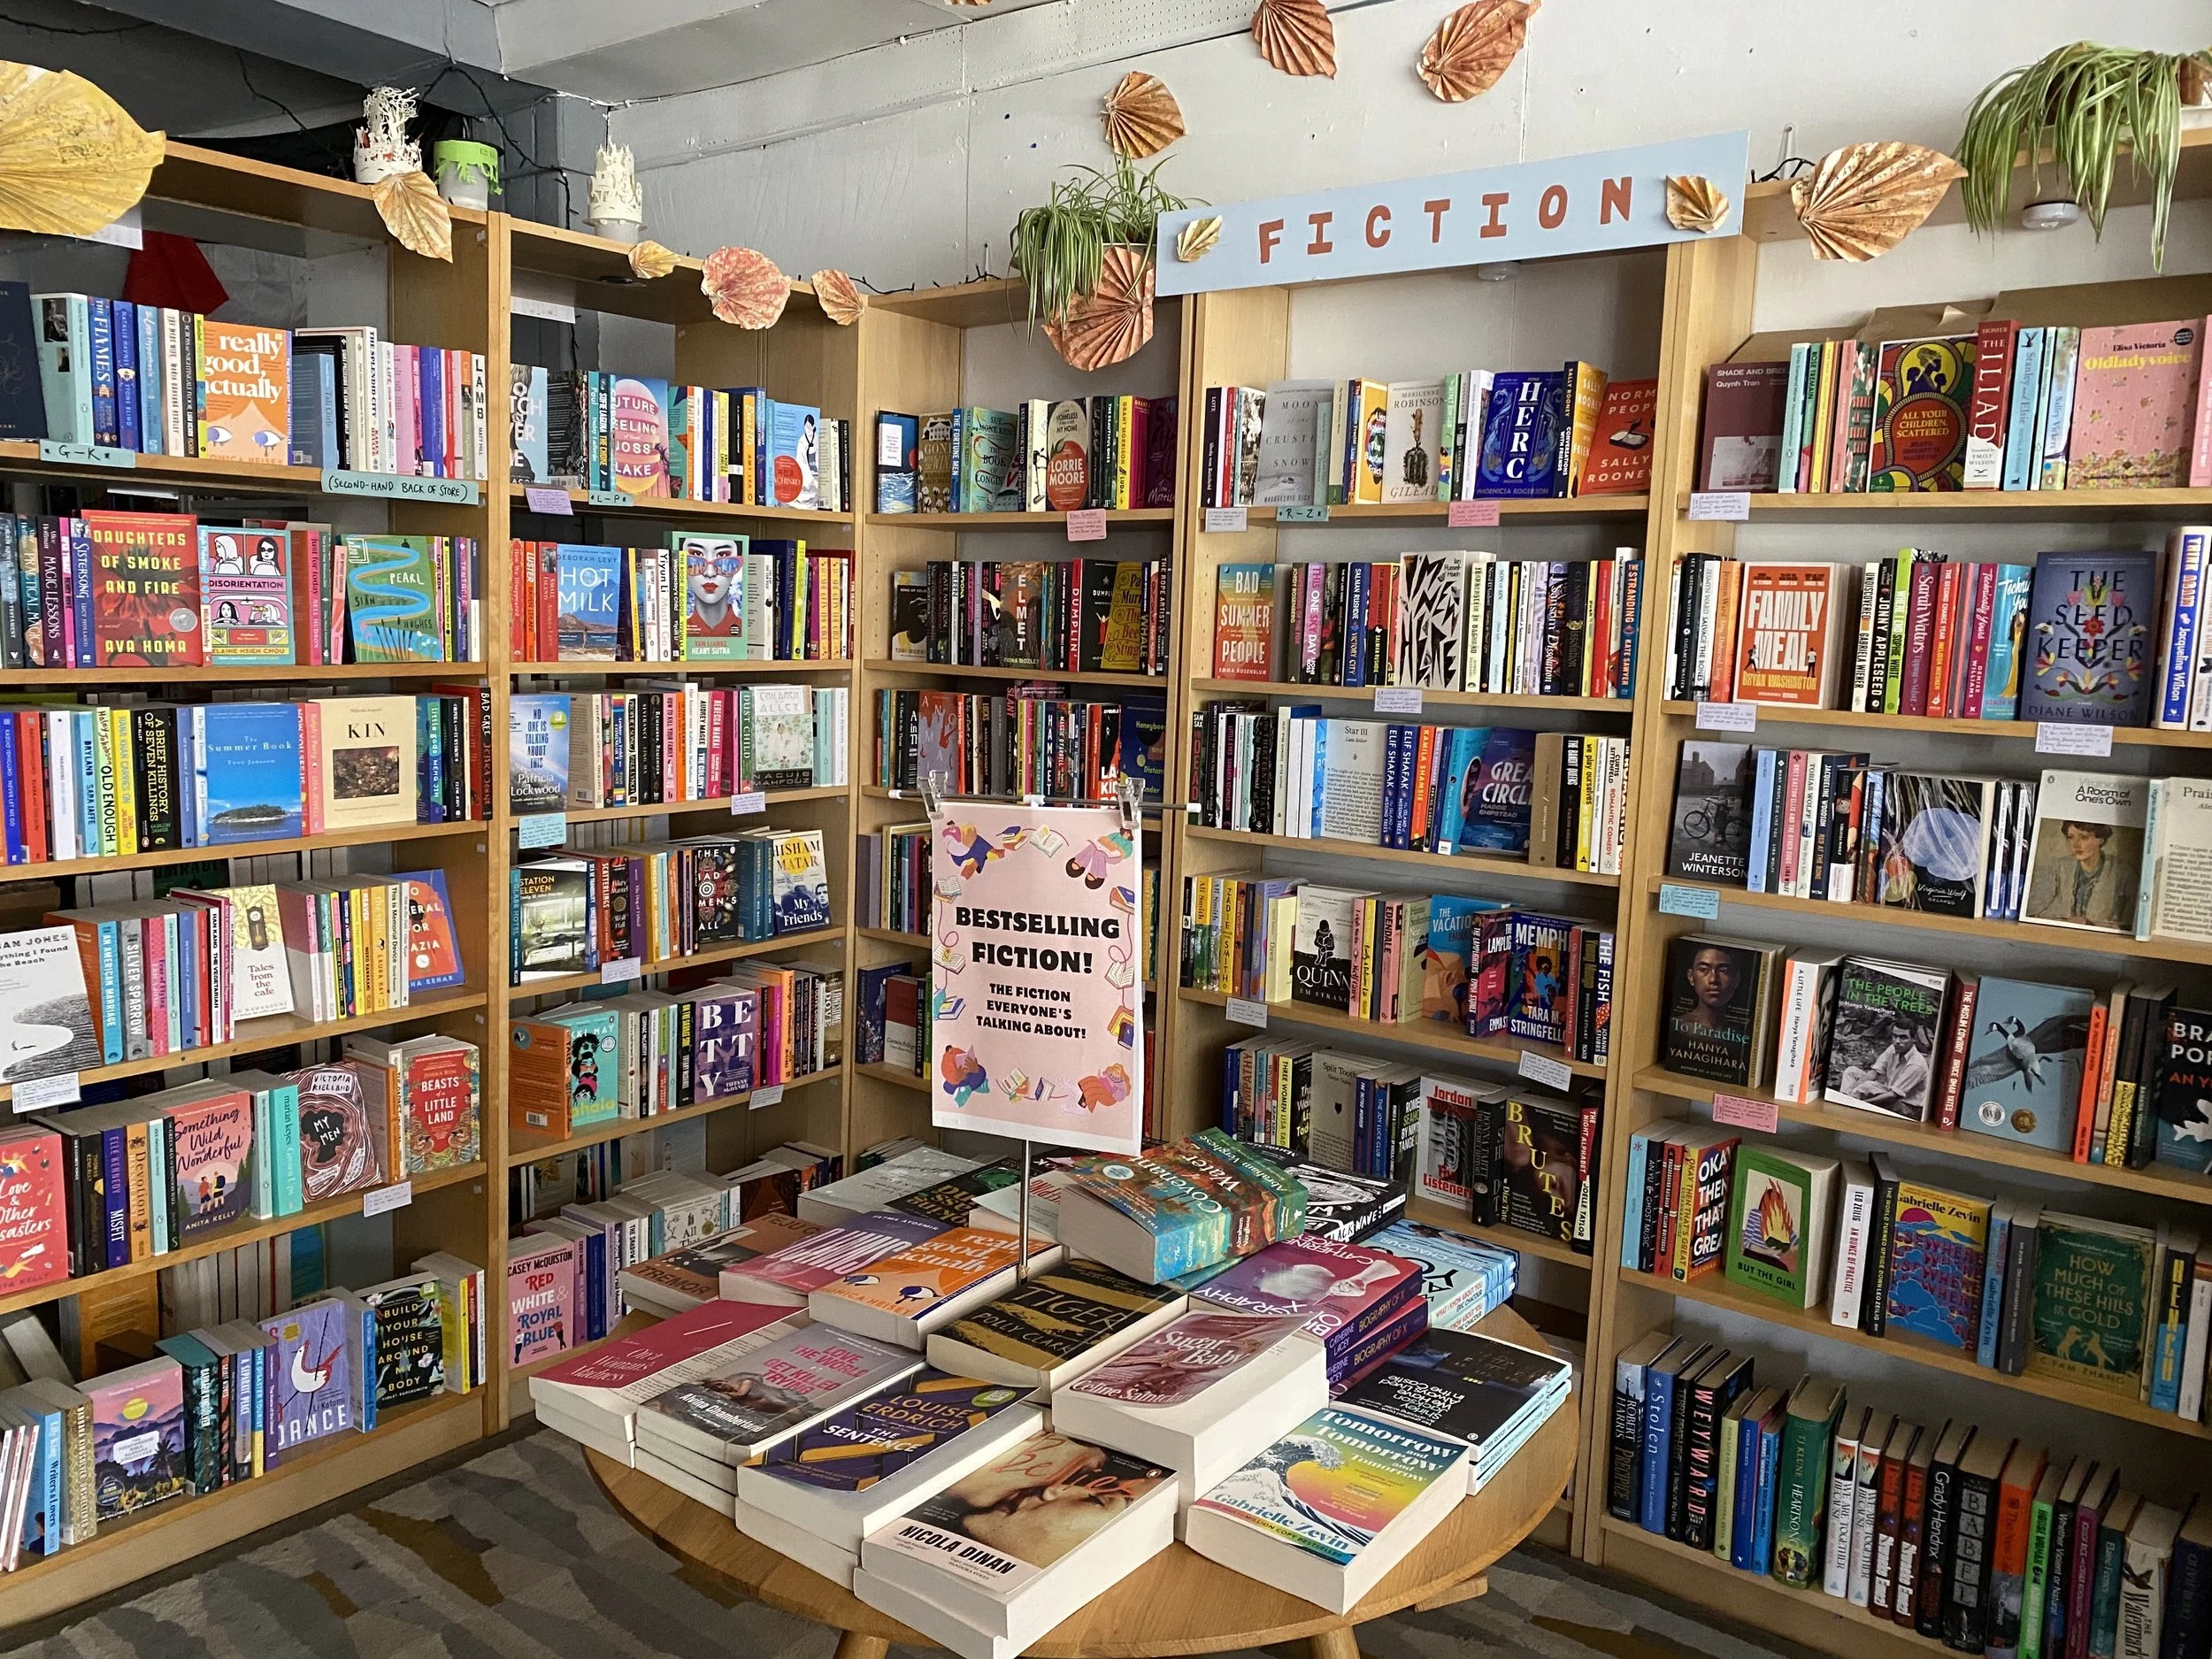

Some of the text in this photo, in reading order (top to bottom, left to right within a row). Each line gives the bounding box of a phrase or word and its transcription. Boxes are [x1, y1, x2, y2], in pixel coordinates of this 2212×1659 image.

[1259, 176, 1632, 264] FICTION
[219, 332, 281, 361] really
[204, 356, 266, 381] good,
[1717, 380, 1740, 389] Quynh
[1975, 352, 2003, 443] ILIAD
[1900, 419, 1947, 429] CHILDREN
[1902, 410, 1947, 421] ALL YOUR
[1507, 381, 1542, 479] HERC
[1897, 428, 1948, 438] SCATTERED
[1050, 458, 1083, 472] LORRIE
[402, 480, 424, 494] BACK
[427, 484, 435, 494] OF
[1050, 472, 1085, 486] MOORE
[1390, 486, 1438, 497] GILEAD
[94, 531, 185, 546] DAUGHTERS
[101, 557, 180, 570] OF SMOKE
[209, 580, 284, 590] DISORIENTATION
[390, 573, 424, 585] PEARL
[560, 568, 612, 586] HOT
[1235, 572, 1259, 594] BAD
[106, 581, 179, 594] AND FIRE
[662, 584, 667, 594] Li
[559, 591, 613, 612] MILK
[1221, 605, 1270, 627] SUMMER
[1748, 591, 1824, 632] FAMILY
[403, 619, 432, 629] HUGHES
[105, 641, 186, 652] AVA HOMA
[1222, 641, 1265, 664] PEOPLE
[1754, 630, 1807, 672] MEAL
[1871, 597, 1889, 695] JONNY APPLESEED
[534, 709, 541, 718] NO
[349, 722, 386, 738] KIN
[528, 719, 546, 732] ONE IS
[1345, 726, 1359, 735] Star
[526, 733, 549, 744] TALKING
[528, 745, 547, 757] ABOUT
[1386, 728, 1398, 790] ELIF SHAFAK
[531, 757, 543, 768] THIS
[518, 772, 554, 784] Patricia
[511, 782, 560, 795] Lockwood
[2087, 787, 2117, 796] Room
[101, 766, 115, 841] OLD ENOUGH
[2076, 795, 2131, 806] One's Own
[1689, 853, 1744, 866] JEANETTE
[520, 875, 554, 886] STATION
[520, 885, 550, 895] ELEVEN
[794, 898, 808, 910] My
[784, 910, 823, 926] Friends
[956, 906, 1120, 939] BESTSELLING
[972, 941, 1093, 974] FICTION!
[248, 964, 274, 972] Tales
[250, 972, 273, 981] from
[103, 948, 115, 1026] AMERICAN MARRIAGE
[126, 941, 143, 1034] SILVER SPARROW
[990, 983, 1071, 1002] THE FICTION
[987, 1000, 1071, 1020] EVERYONE'S
[976, 1016, 1087, 1039] TALKING ABOUT!
[1674, 1019, 1750, 1044] To Paradise
[313, 1074, 351, 1084] VICTORIA
[421, 1077, 459, 1092] BEASTS
[425, 1097, 456, 1112] LITTLE
[1432, 1086, 1472, 1107] Jordan
[175, 1108, 240, 1141] Something
[313, 1117, 329, 1132] MY
[427, 1110, 454, 1125] LAND
[191, 1131, 224, 1151] Wild
[320, 1127, 341, 1145] MEN
[111, 1209, 124, 1242] MISFIT
[185, 1210, 235, 1230] ANITA KELLY
[902, 1219, 939, 1231] AYDEMIR
[526, 1273, 554, 1290] RED
[638, 1266, 710, 1298] TREMOR
[1737, 1263, 1797, 1290] BUT THE GIRL
[384, 1303, 419, 1318] BUILD
[512, 1290, 554, 1314] WHITE
[1016, 1286, 1128, 1332] TIGER
[385, 1318, 418, 1332] YOUR
[518, 1308, 563, 1327] ROYAL
[972, 1312, 1018, 1335] POLLY
[1358, 1300, 1392, 1333] BIOGRAPHY
[382, 1332, 423, 1348] HOUSE
[524, 1326, 554, 1346] BLUE
[1156, 1332, 1227, 1351] Sugar
[1330, 1323, 1355, 1348] CATHERINE
[379, 1346, 429, 1364] AROUND
[823, 1345, 863, 1363] LOVE
[1179, 1344, 1242, 1369] Baby
[1333, 1340, 1350, 1356] LACEY
[396, 1364, 412, 1375] MY
[791, 1344, 871, 1379] THE WORLD
[763, 1359, 841, 1391] GET KILLED
[764, 1371, 815, 1394] TRYING
[388, 1378, 419, 1391] BODY
[1072, 1378, 1127, 1397] Celine
[680, 1393, 767, 1432] Alvina Chamberland
[862, 1402, 963, 1431] ERDRICH
[889, 1394, 974, 1421] LOUISE
[822, 1425, 924, 1453] SENTENCE
[871, 1427, 898, 1440] THE
[1321, 1410, 1459, 1460] Tomorrow
[1316, 1425, 1444, 1474] Tomorrow
[1211, 1492, 1350, 1553] Gabrielle Zevin
[1929, 1471, 1950, 1559] Grady Hendrix
[899, 1525, 1017, 1575] NICOLA DINAN
